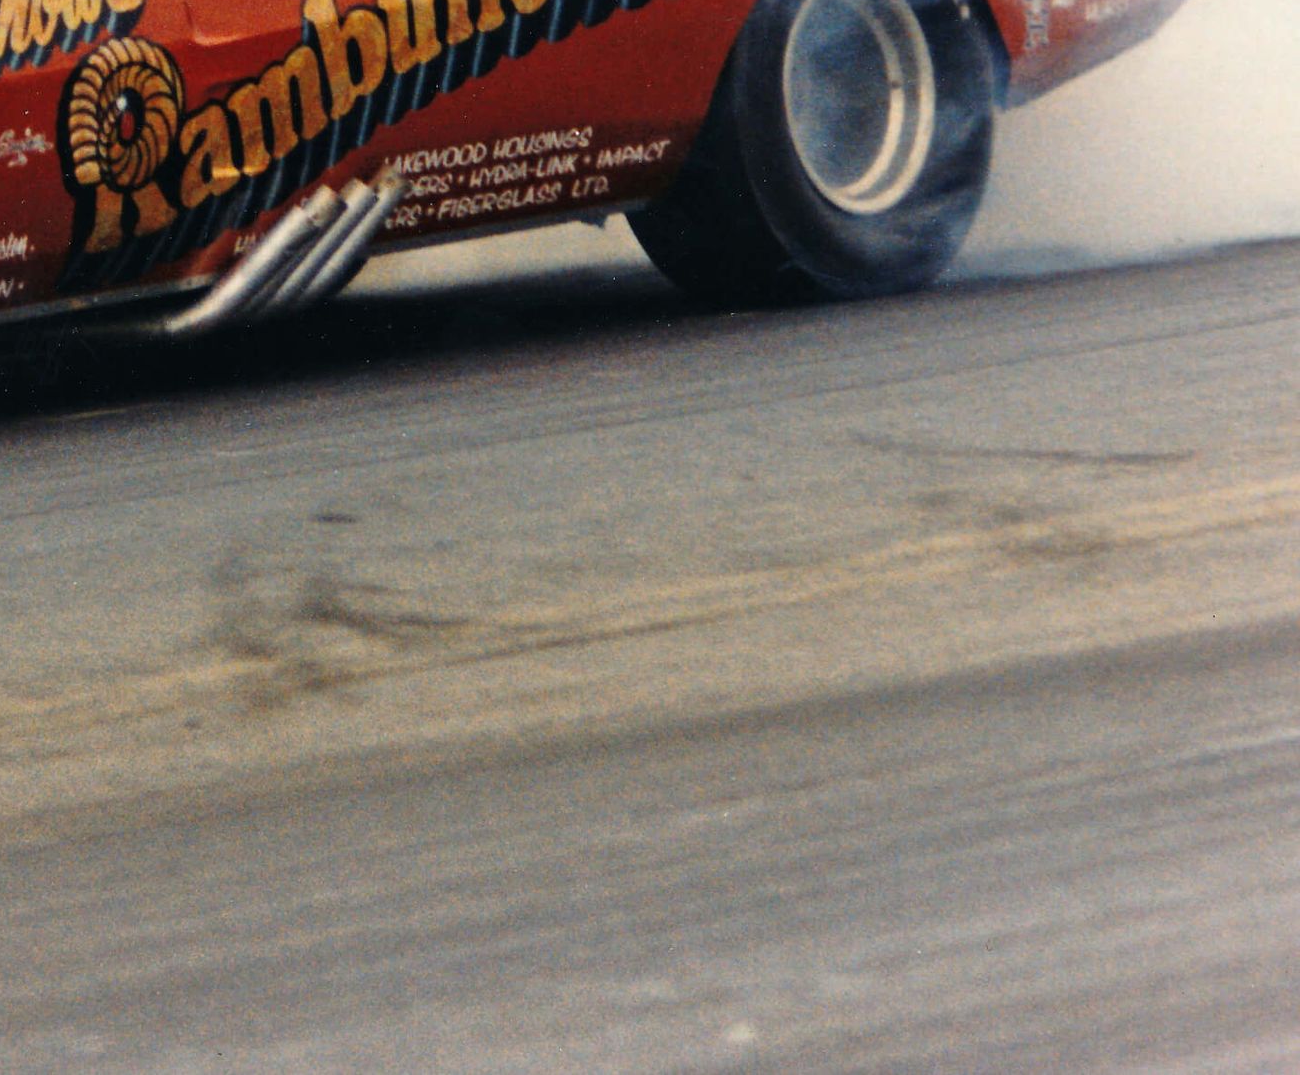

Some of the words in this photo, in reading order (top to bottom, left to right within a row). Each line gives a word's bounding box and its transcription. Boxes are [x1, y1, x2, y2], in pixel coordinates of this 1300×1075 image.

[384, 142, 487, 175] AKEWOOD
[493, 126, 593, 159] HOUSINGS
[596, 138, 671, 169] IMPACT
[437, 180, 563, 221] FIBERGLASS
